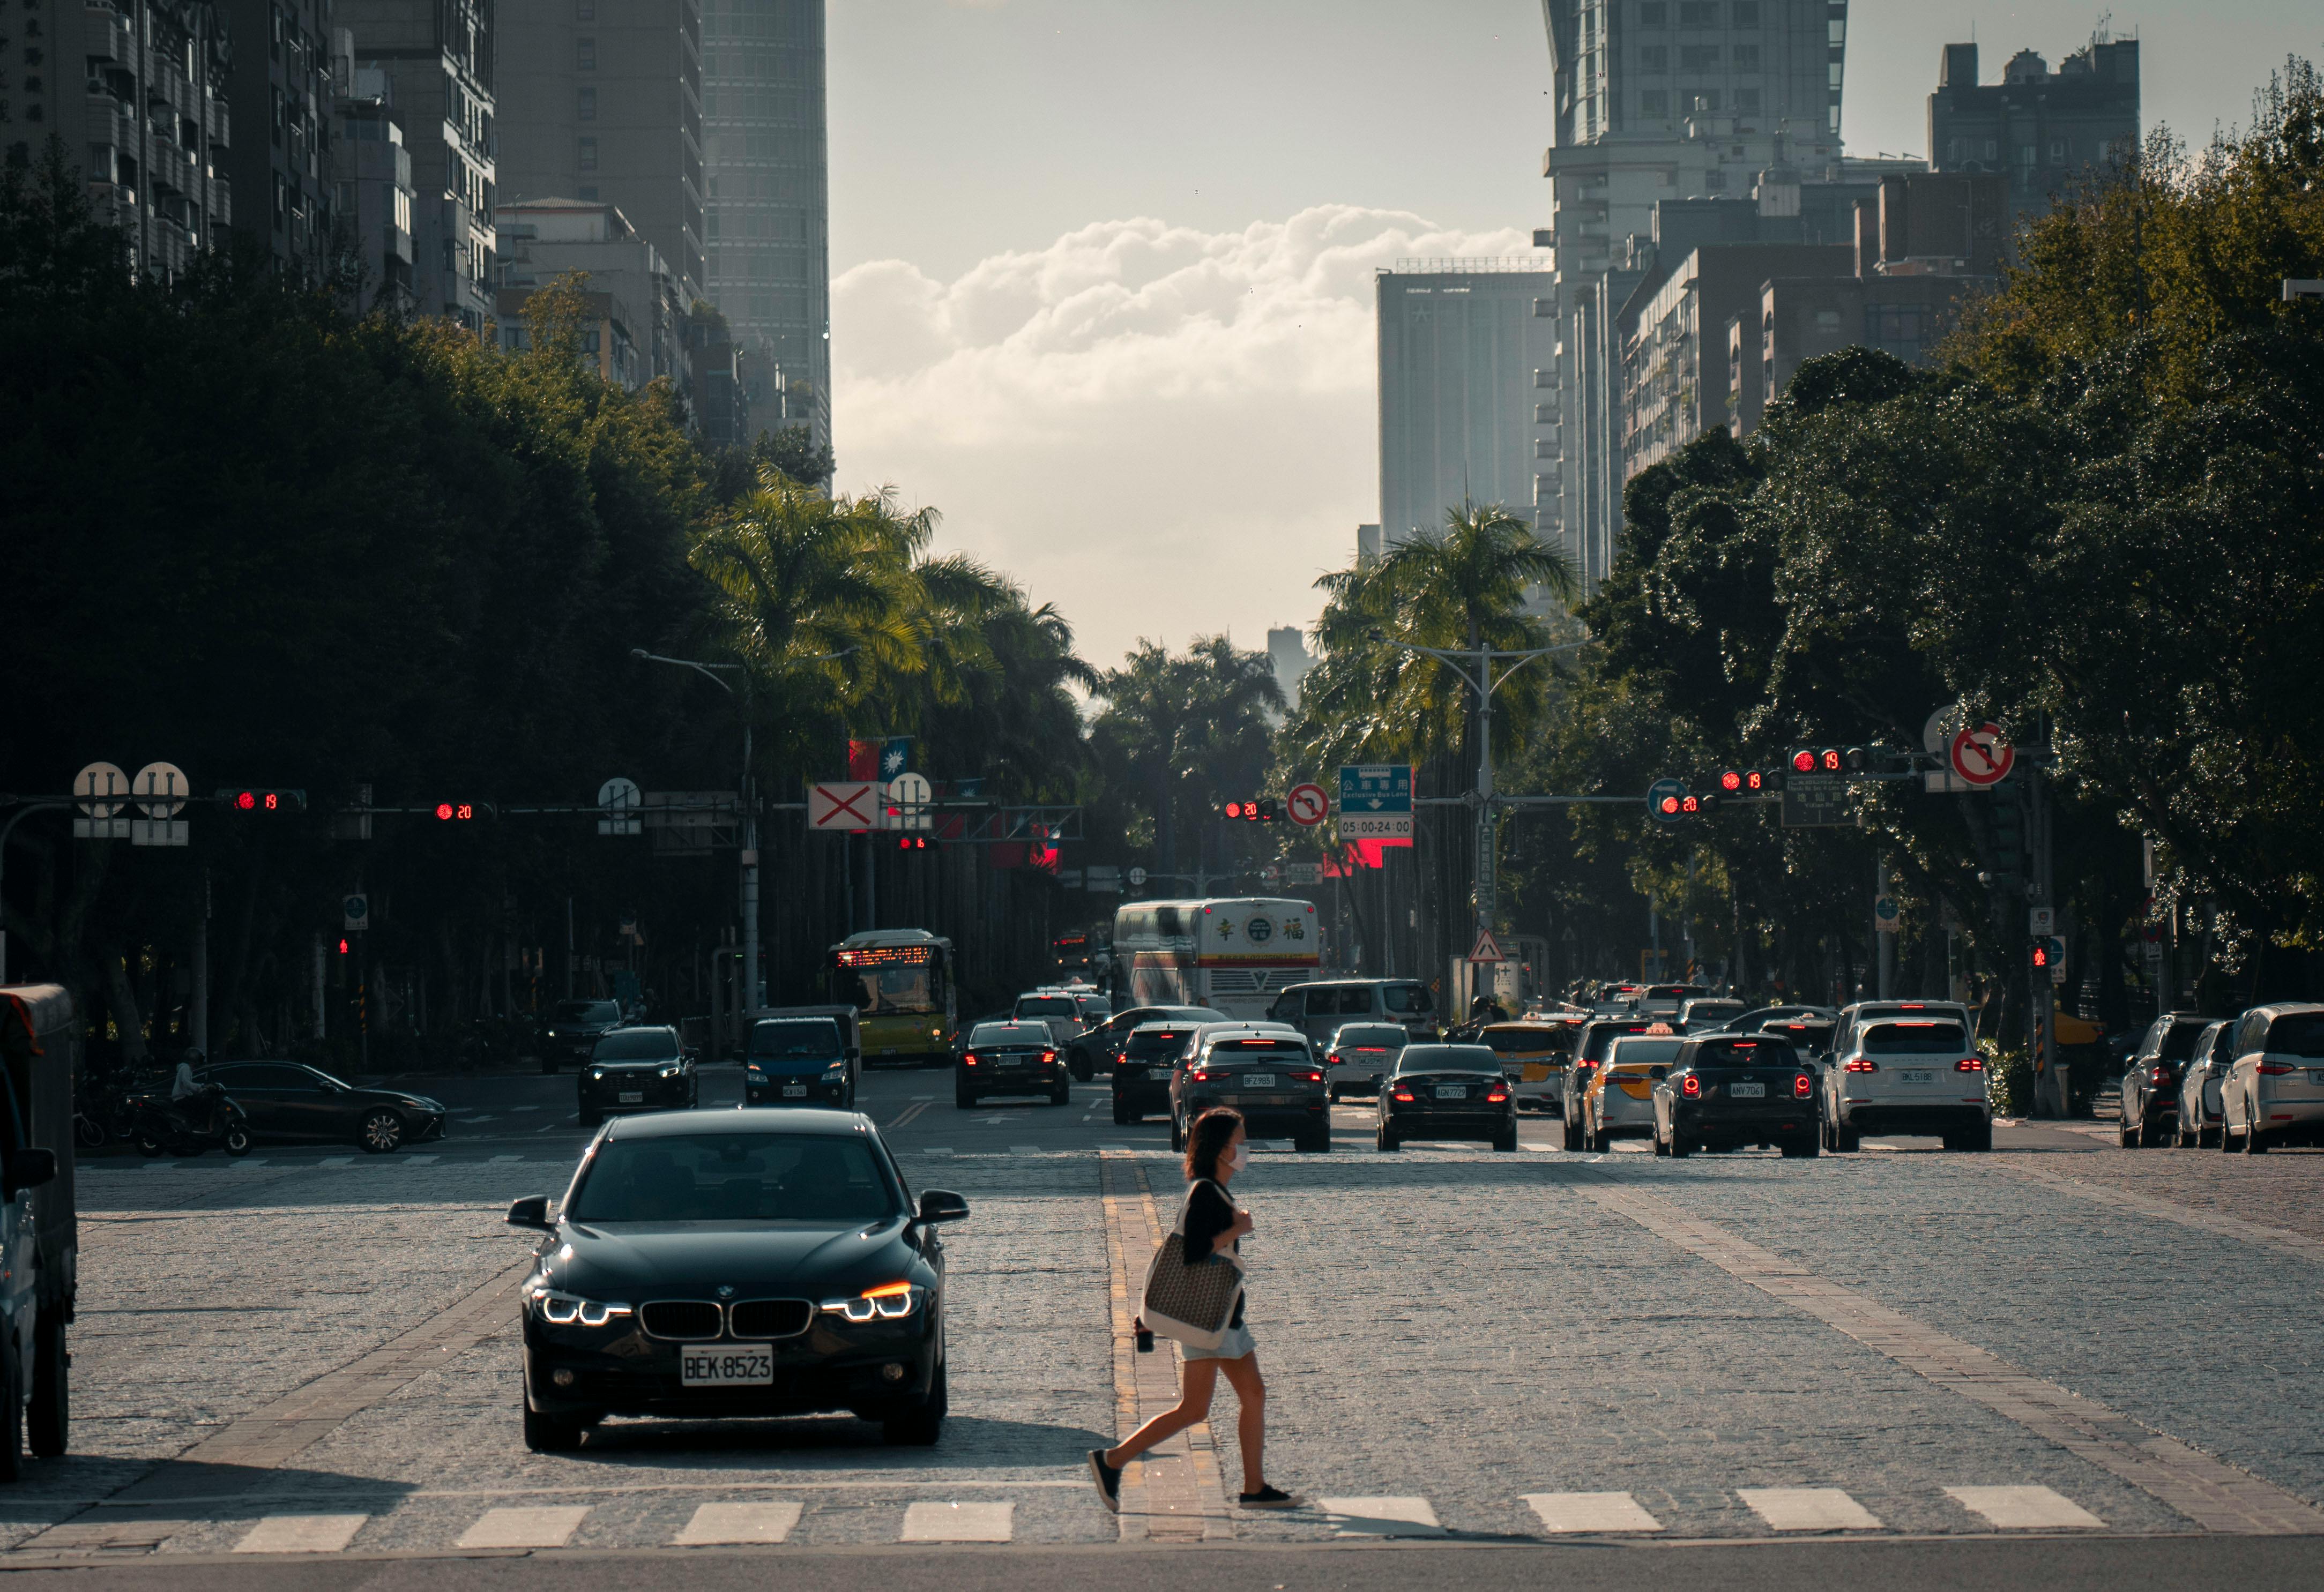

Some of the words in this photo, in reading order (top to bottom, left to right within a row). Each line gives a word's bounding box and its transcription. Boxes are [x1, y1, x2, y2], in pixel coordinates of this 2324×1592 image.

[1826, 752, 1838, 769] 19
[1343, 780, 1408, 790] 公車專用
[1749, 774, 1760, 788] 19
[266, 795, 276, 809] 19
[1684, 797, 1696, 811] 20
[458, 805, 471, 818] 20
[1245, 804, 1256, 815] 20
